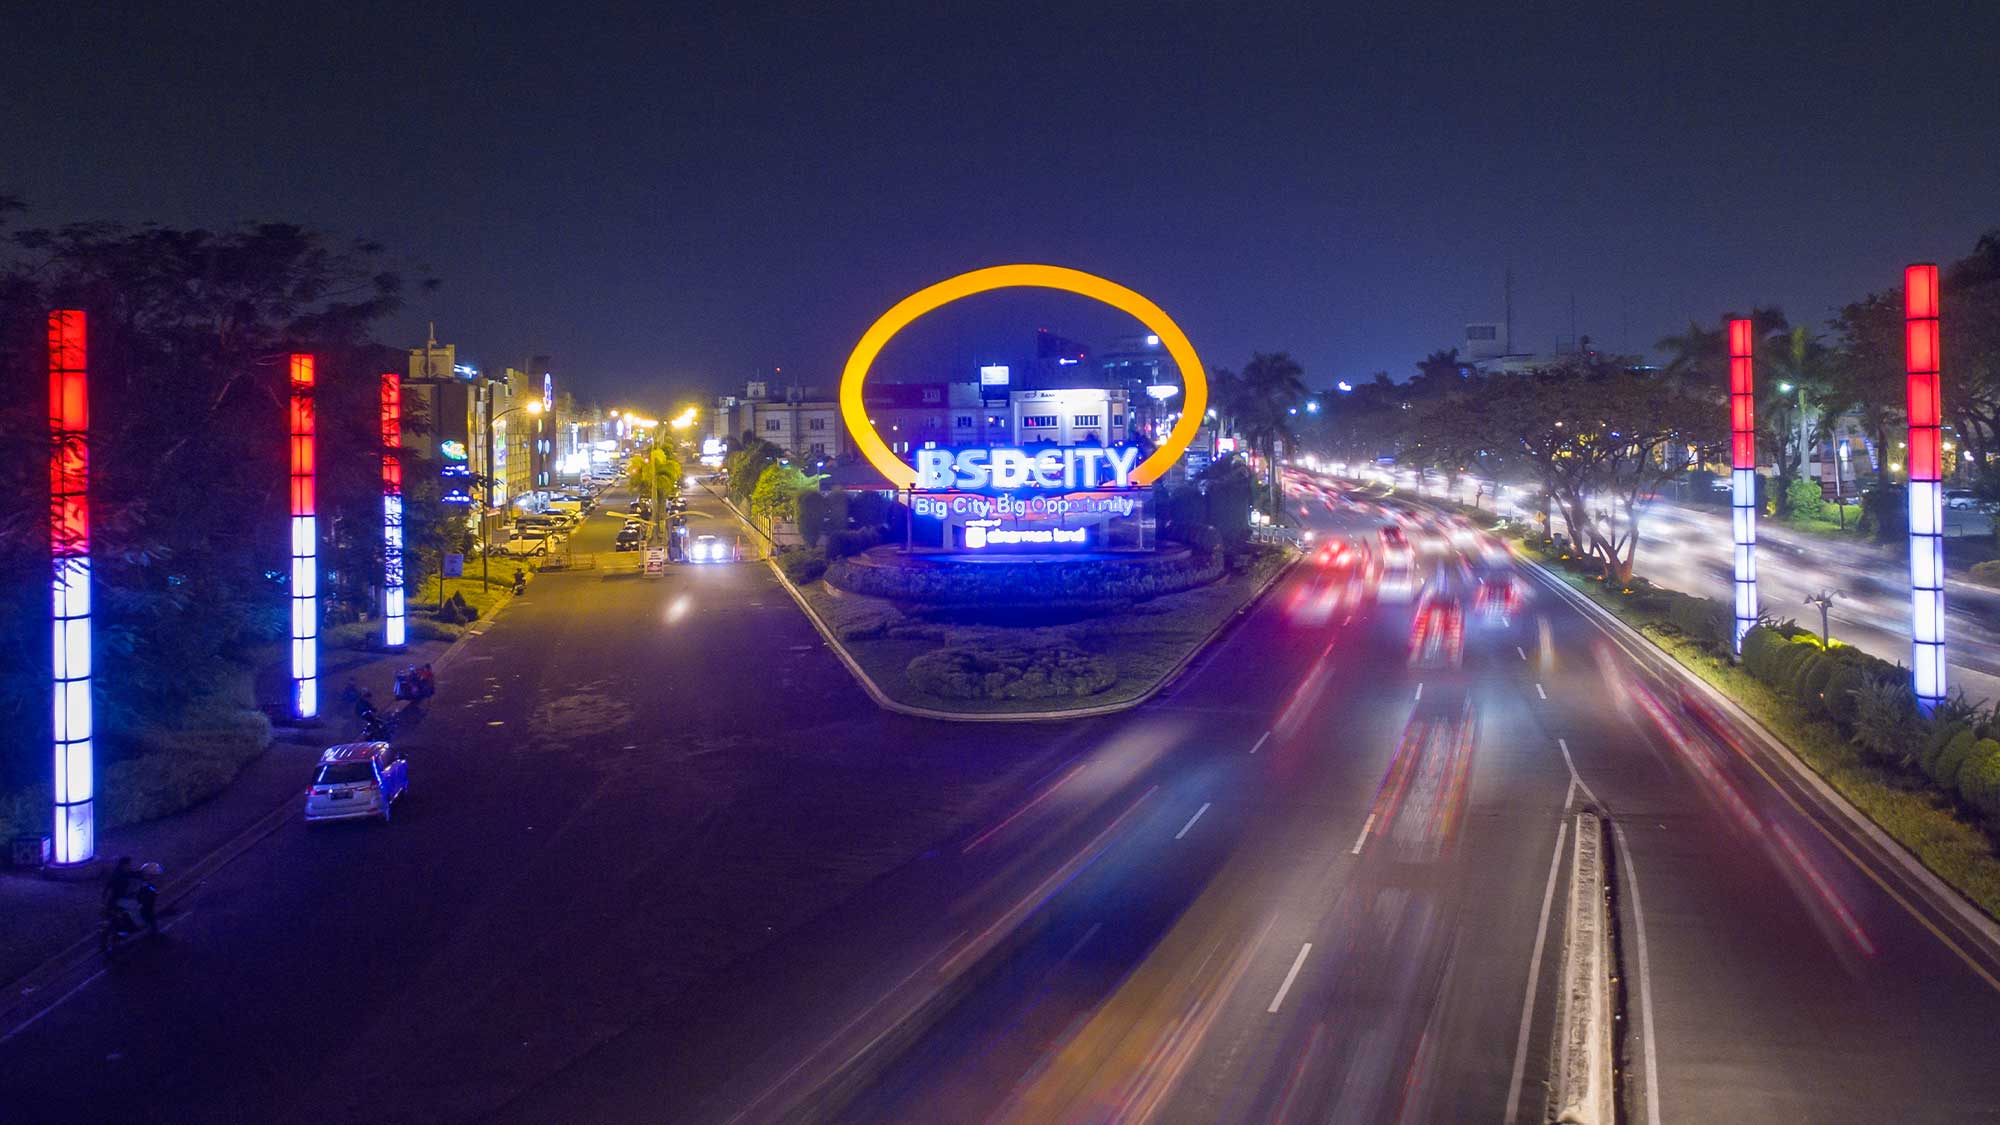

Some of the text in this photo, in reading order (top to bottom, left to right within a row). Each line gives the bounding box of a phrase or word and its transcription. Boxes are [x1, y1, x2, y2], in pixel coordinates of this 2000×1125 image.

[917, 448, 1138, 488] BSD CITY
[916, 498, 947, 517] Big
[997, 496, 1025, 516] Big
[1031, 496, 1134, 516] Opportunity
